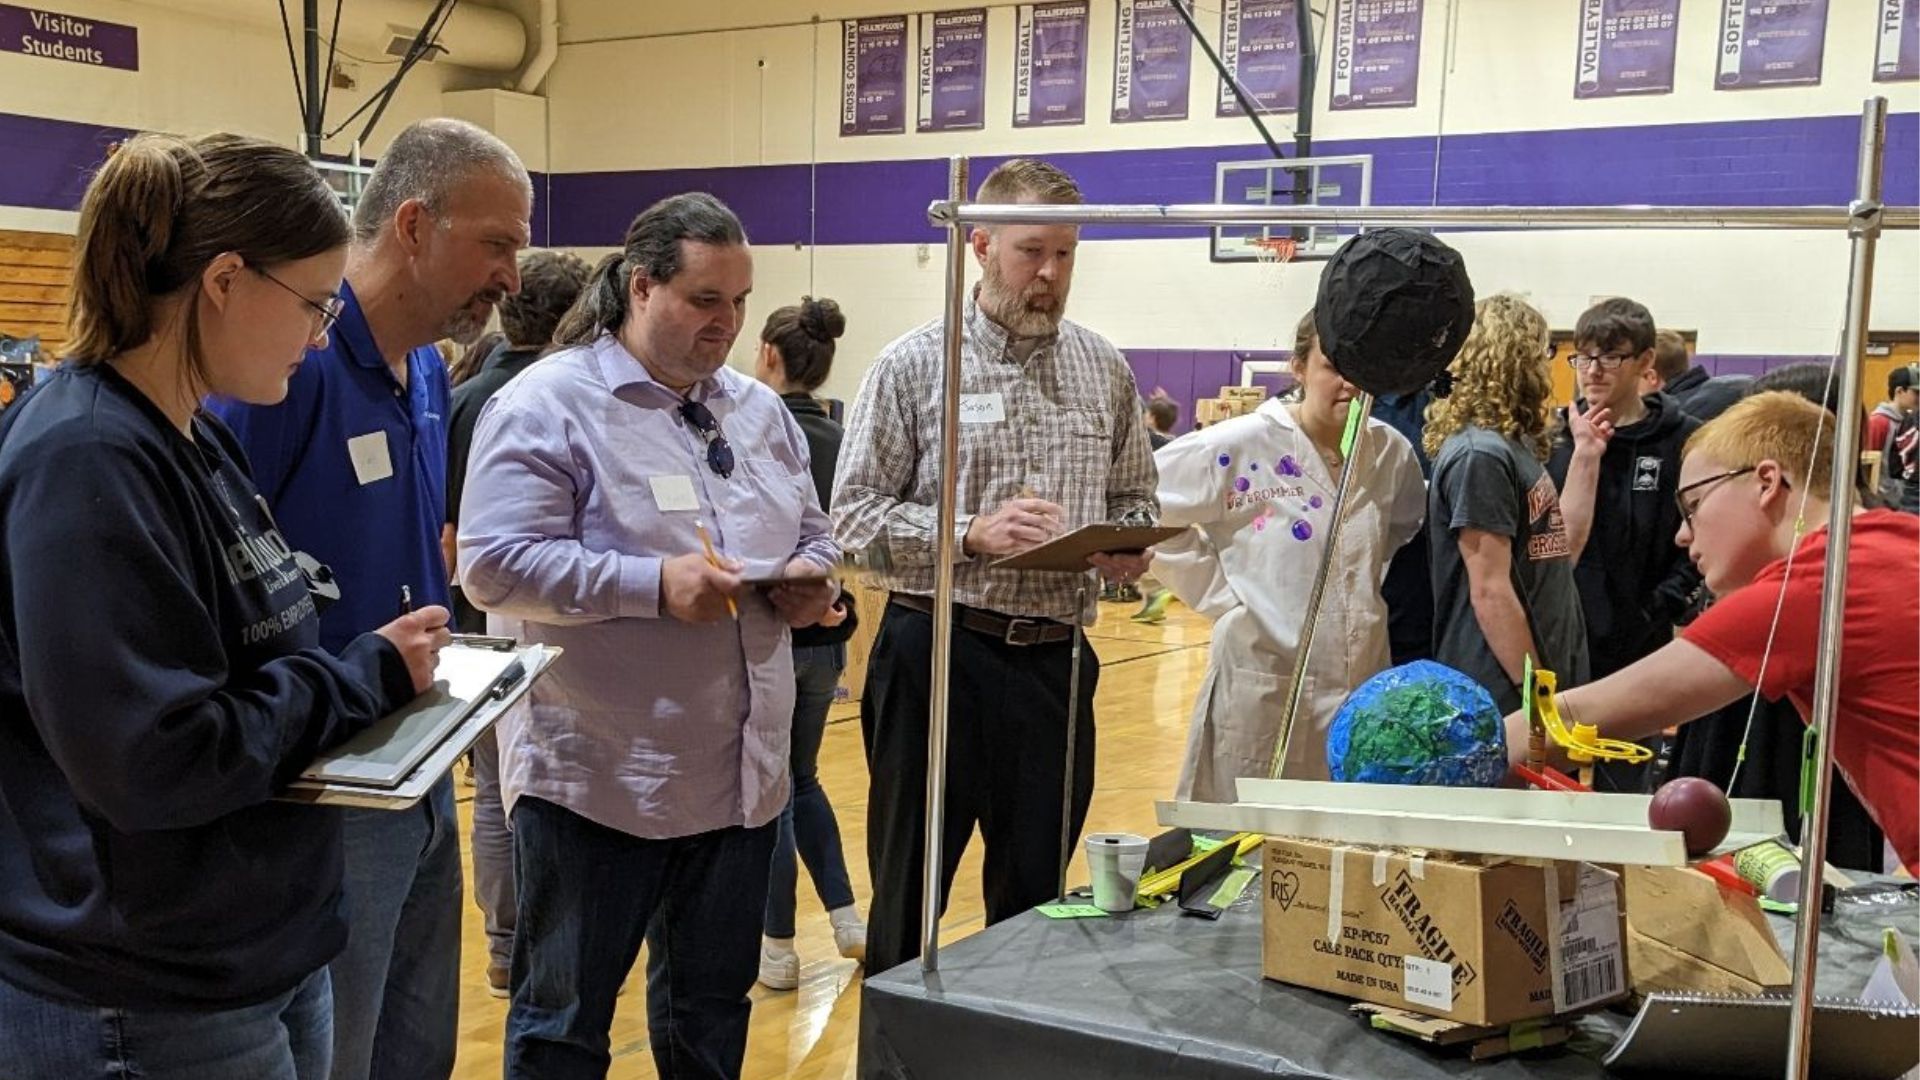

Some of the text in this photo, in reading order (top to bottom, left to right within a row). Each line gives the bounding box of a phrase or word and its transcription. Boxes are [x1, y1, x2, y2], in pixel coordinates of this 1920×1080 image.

[30, 10, 93, 38] Visitor
[22, 34, 104, 64] Students
[1019, 19, 1031, 97] BASEBALL
[1117, 6, 1132, 99] WRESTLING
[1223, 0, 1238, 96] BSKETBAL
[845, 23, 857, 121] CROSS COUNTRY
[921, 46, 932, 97] TRACK
[241, 614, 283, 646] 100%
[1313, 939, 1343, 956] CASE
[1344, 945, 1375, 963] PACK
[1395, 880, 1468, 986] FRAGILE
[1336, 970, 1365, 985] MADE
[1366, 976, 1377, 988] IN
[1379, 979, 1400, 993] USA
[1529, 989, 1552, 1003] MAD
